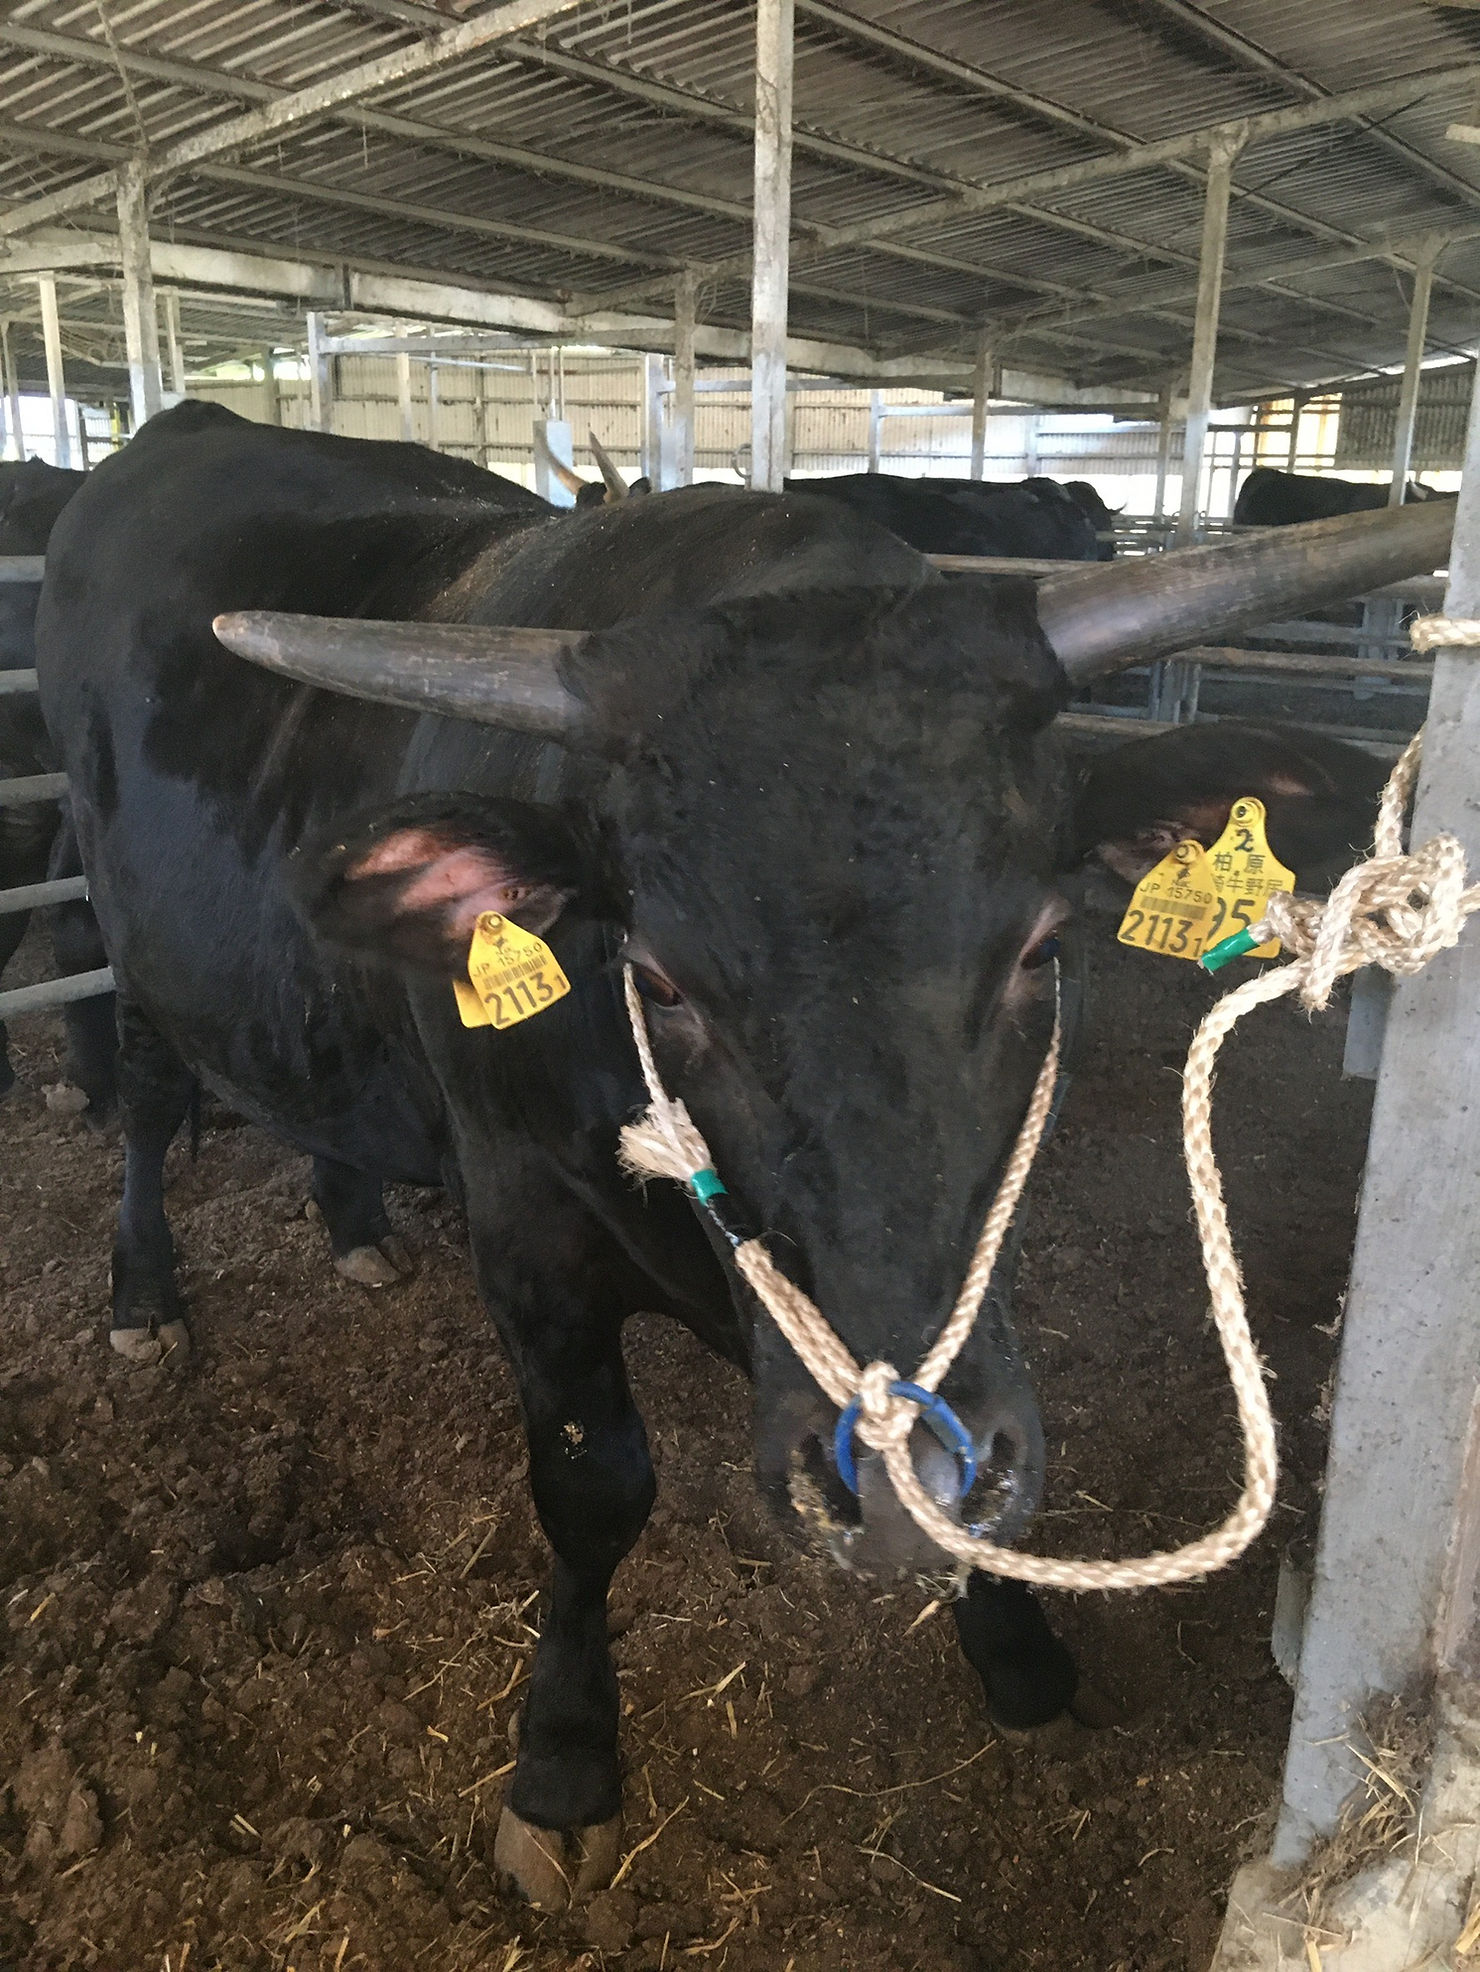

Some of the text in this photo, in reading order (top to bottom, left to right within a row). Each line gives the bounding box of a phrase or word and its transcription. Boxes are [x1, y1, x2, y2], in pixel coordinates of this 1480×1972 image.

[1140, 882, 1160, 894] JP
[1167, 886, 1213, 904] 15750
[1121, 909, 1193, 953] 2113
[473, 963, 490, 978] JP
[498, 942, 542, 967] 15750
[485, 972, 567, 1026] 2113 1
